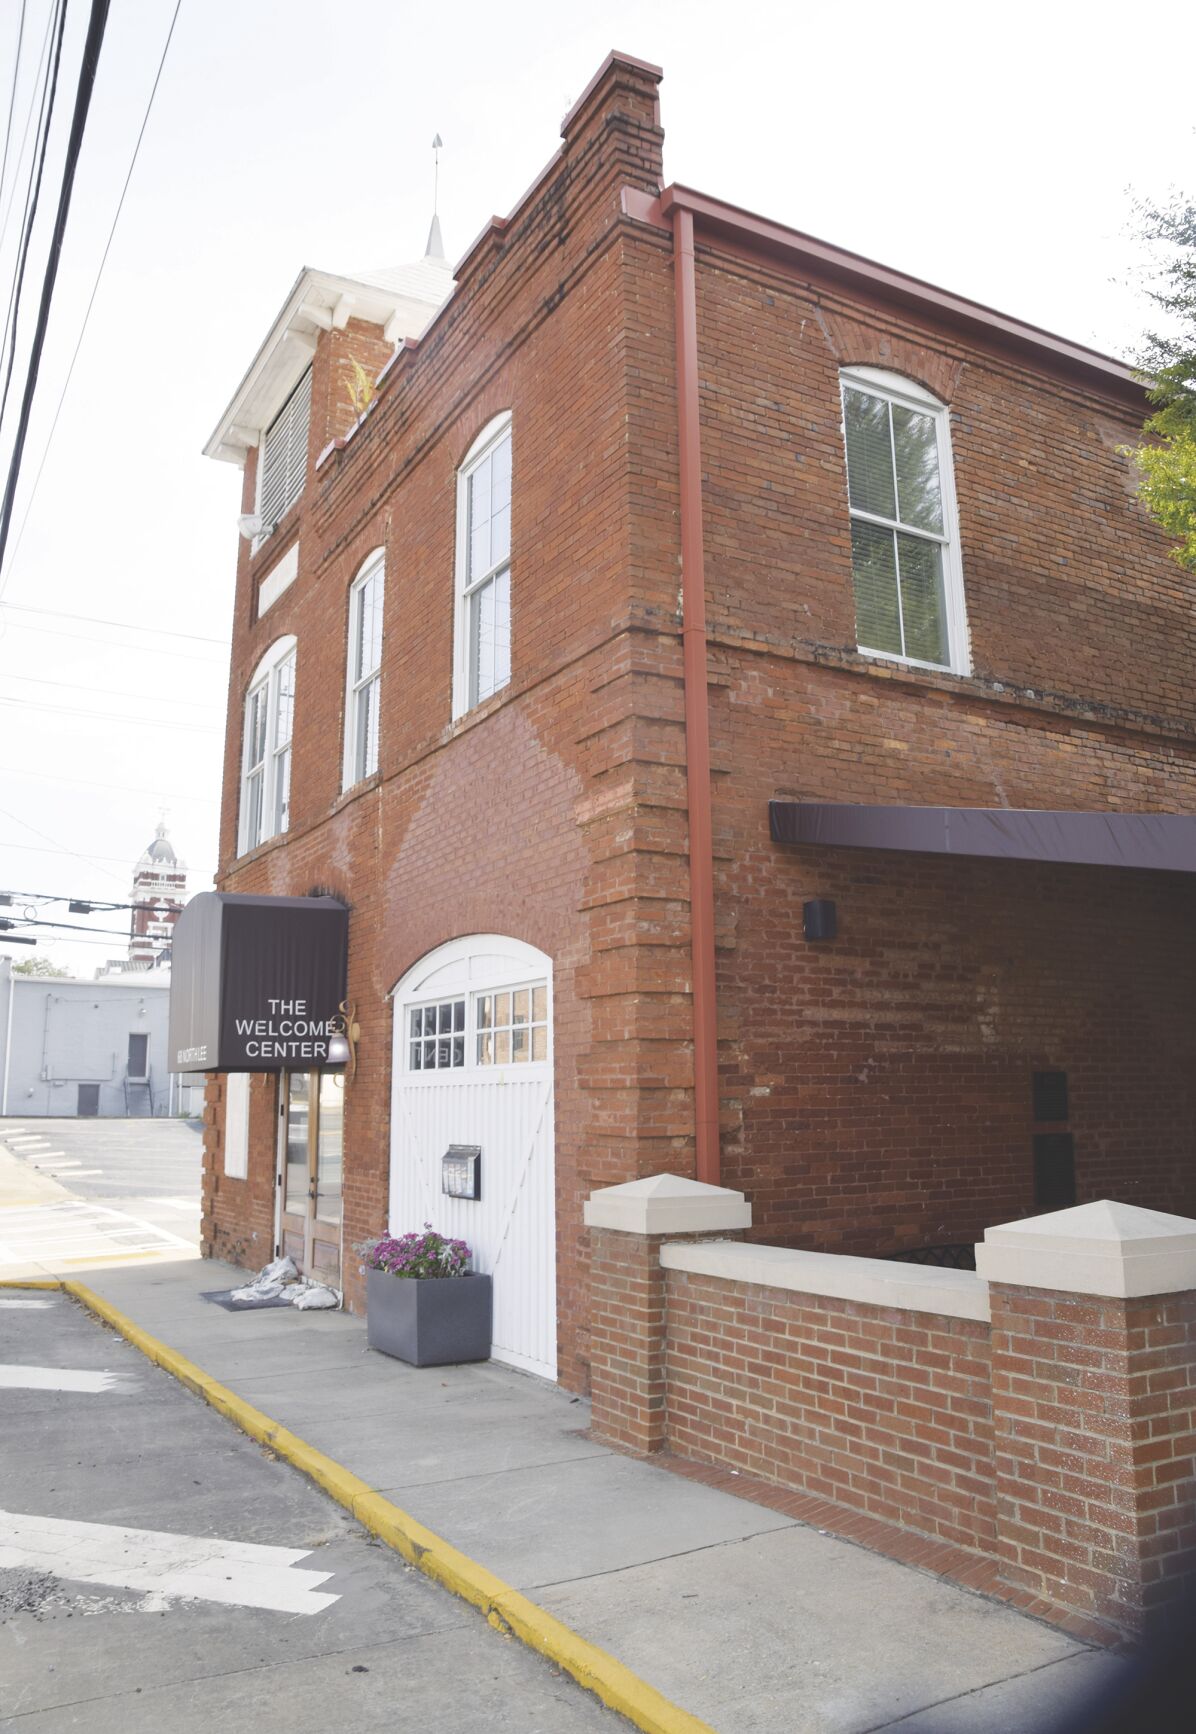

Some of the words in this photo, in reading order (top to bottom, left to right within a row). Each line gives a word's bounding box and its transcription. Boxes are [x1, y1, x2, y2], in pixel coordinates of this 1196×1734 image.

[268, 999, 307, 1015] THE
[235, 1019, 337, 1037] WELCOME
[245, 1041, 327, 1058] CENTER
